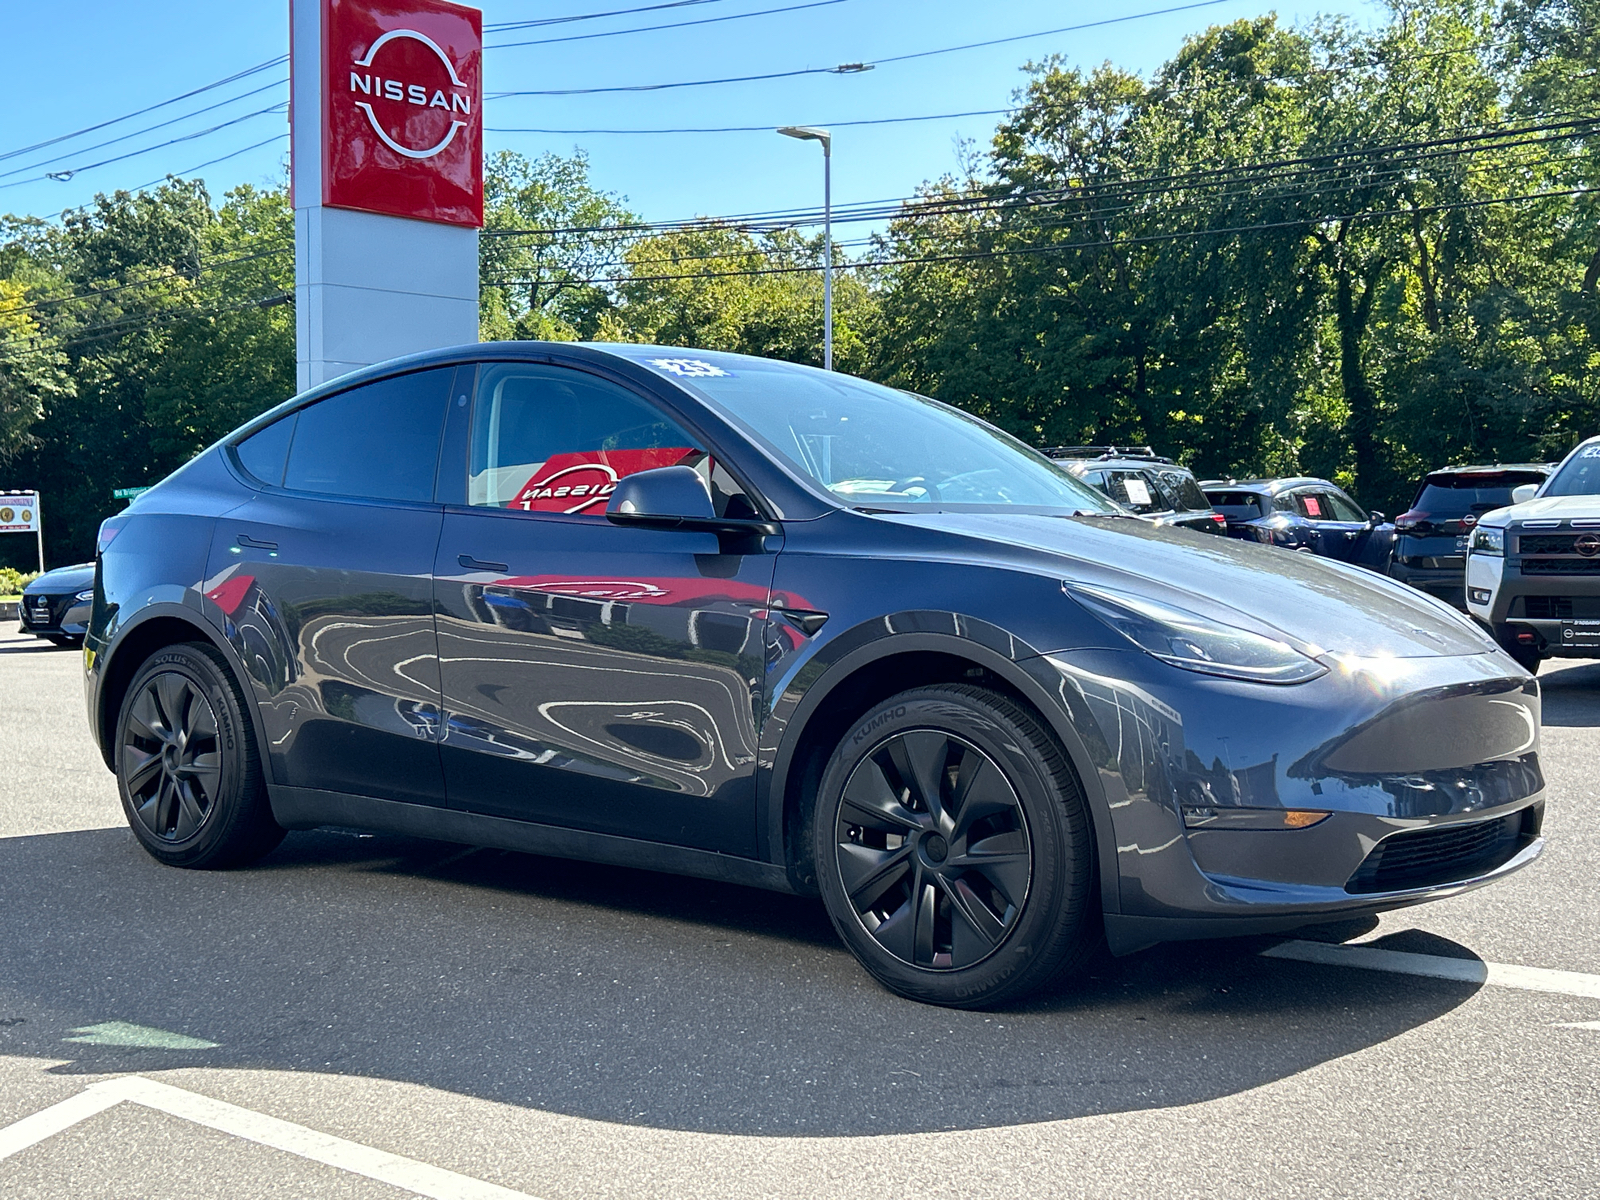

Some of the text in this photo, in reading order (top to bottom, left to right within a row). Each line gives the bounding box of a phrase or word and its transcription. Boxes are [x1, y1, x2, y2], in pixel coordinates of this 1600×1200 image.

[350, 72, 471, 115] NISSAN
[154, 654, 187, 666] SOLUS
[216, 696, 234, 751] KUMHO
[852, 705, 907, 745] KUMHO
[953, 963, 1017, 998] KUMHO
